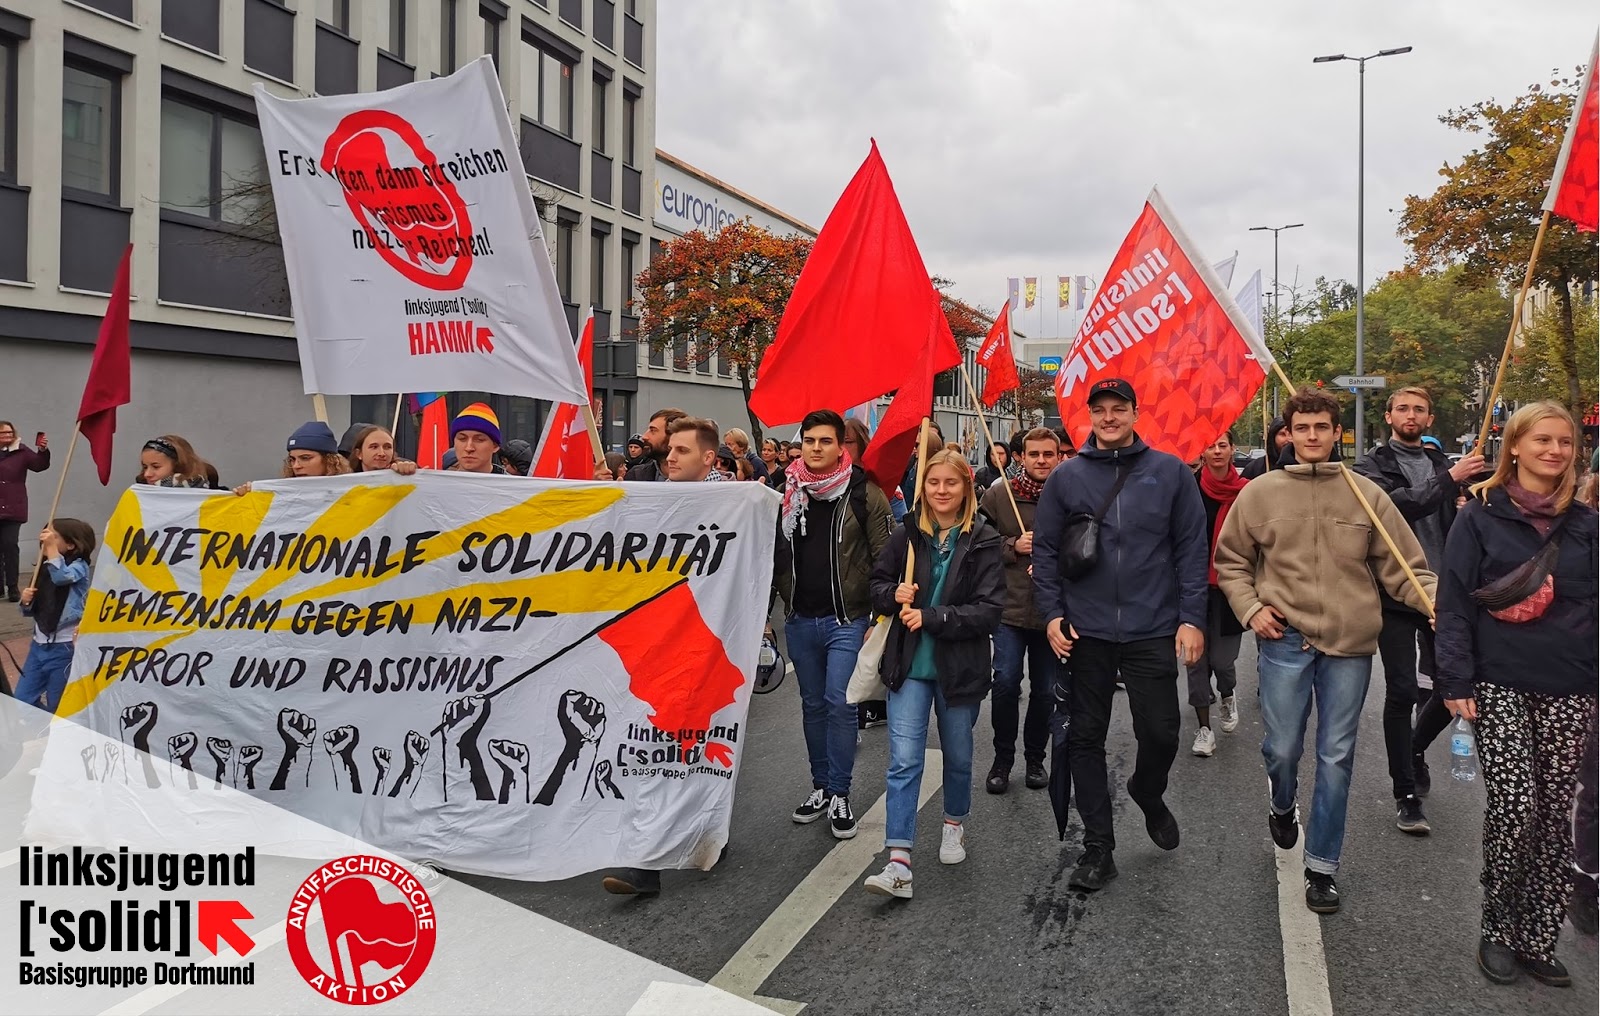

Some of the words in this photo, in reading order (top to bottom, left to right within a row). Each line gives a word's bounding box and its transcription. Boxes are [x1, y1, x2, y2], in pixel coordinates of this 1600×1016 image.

[378, 163, 419, 190] dann
[421, 148, 509, 187] streichen
[416, 227, 494, 260] Reichen!
[404, 297, 460, 316] linksjugend
[408, 320, 475, 355] HAMM
[117, 526, 440, 578] INTERNATIONALE
[458, 524, 737, 577] SOLIDARITÄT
[98, 589, 283, 634] GEMEINSAM
[291, 600, 415, 637] GEGEN
[432, 597, 558, 635] NAZI-
[92, 645, 213, 687] TERROR
[230, 656, 307, 692] UND
[322, 656, 504, 694] RASSISMUS
